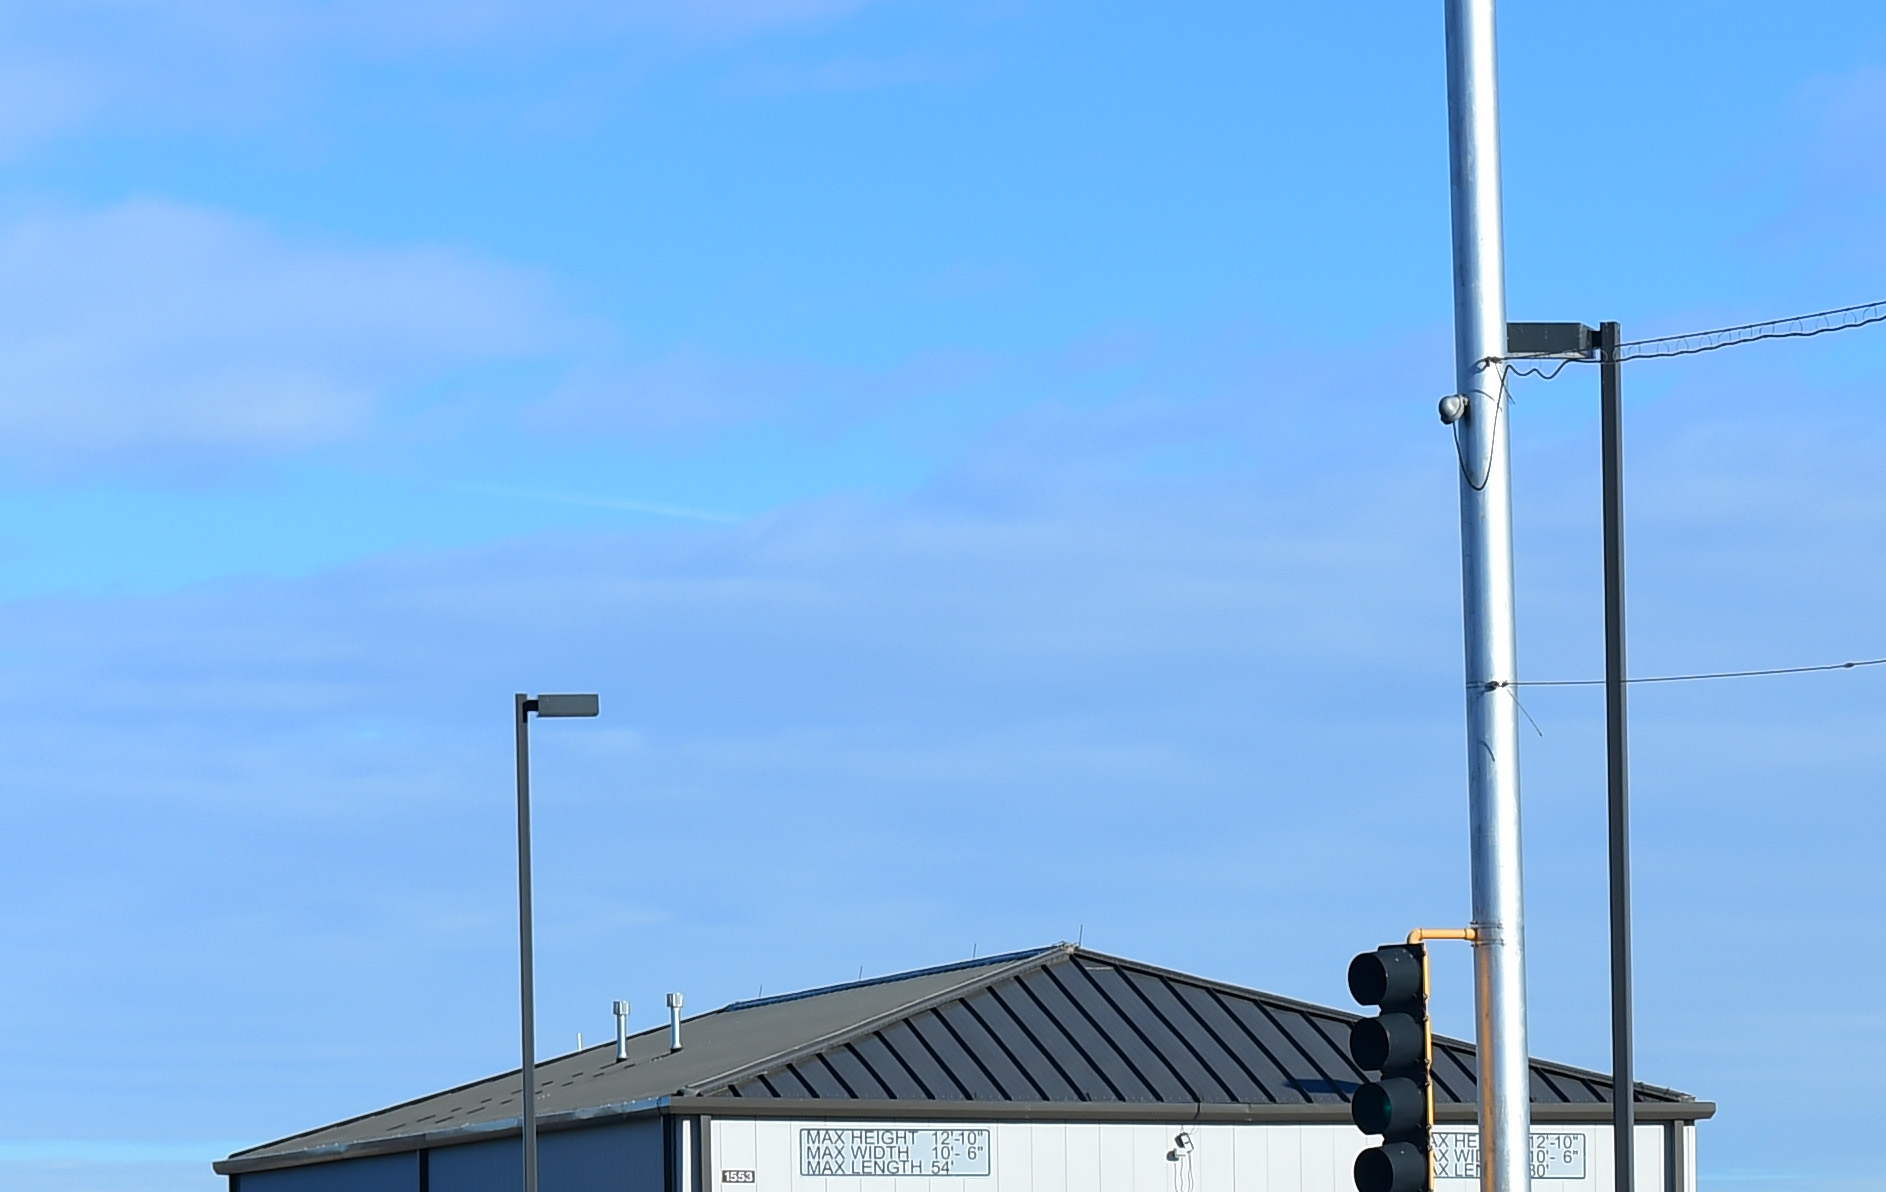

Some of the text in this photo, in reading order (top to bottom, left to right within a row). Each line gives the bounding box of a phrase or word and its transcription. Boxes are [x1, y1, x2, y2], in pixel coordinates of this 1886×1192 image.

[806, 1131, 845, 1144] MAX
[851, 1131, 918, 1145] HEIGHT
[806, 1146, 845, 1160] MAX
[851, 1146, 909, 1160] WIDTH
[806, 1160, 955, 1174] MAX LENGTH 54'
[724, 1171, 754, 1182] 1553
